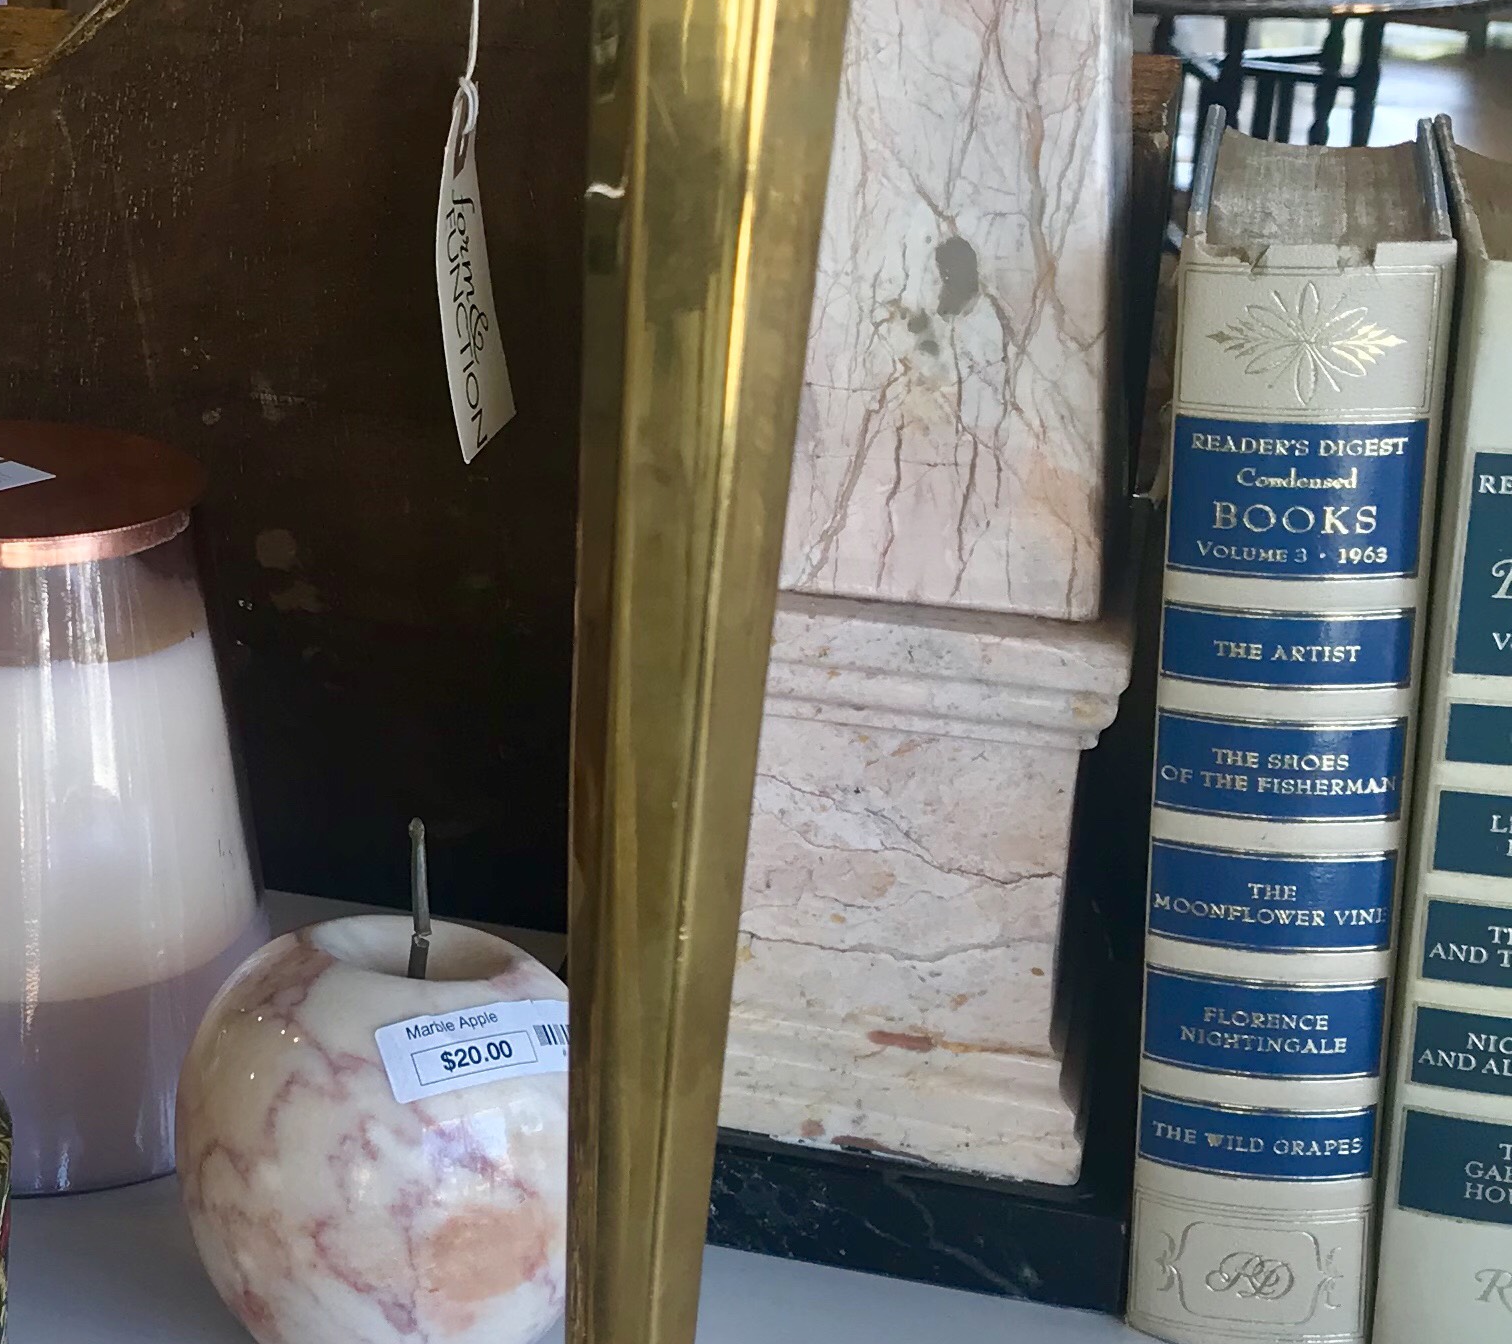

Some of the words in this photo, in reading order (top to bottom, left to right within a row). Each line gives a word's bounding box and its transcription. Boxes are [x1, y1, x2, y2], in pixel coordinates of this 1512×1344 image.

[446, 207, 488, 449] FUNCTION
[1191, 432, 1310, 456] READER'S
[1319, 436, 1410, 456] DIGEST
[1236, 466, 1358, 489] Condensed
[1212, 500, 1377, 535] BOOKS
[1337, 546, 1388, 564] 1963
[1213, 640, 1263, 660] THE
[1270, 645, 1361, 663] ARTIST
[1211, 747, 1260, 769] THE
[1267, 753, 1349, 771] SHOES
[1160, 764, 1193, 784] OF
[1200, 770, 1248, 791] THE
[1257, 776, 1396, 795] FISHERMAN
[1247, 882, 1296, 902] THE
[1153, 892, 1325, 927] MOONFLOWER
[1334, 907, 1387, 926] VINE
[1428, 942, 1488, 965] AND
[405, 1018, 455, 1041] Marble
[459, 1011, 499, 1031] Apple
[1203, 1007, 1329, 1030] FLORENCE
[1180, 1025, 1348, 1054] NIGHTINGALE
[440, 1039, 513, 1072] $20.00
[1418, 1048, 1476, 1072] AND
[1152, 1120, 1197, 1144] THE
[1204, 1132, 1264, 1153] WILD
[1272, 1137, 1363, 1156] GRAPES
